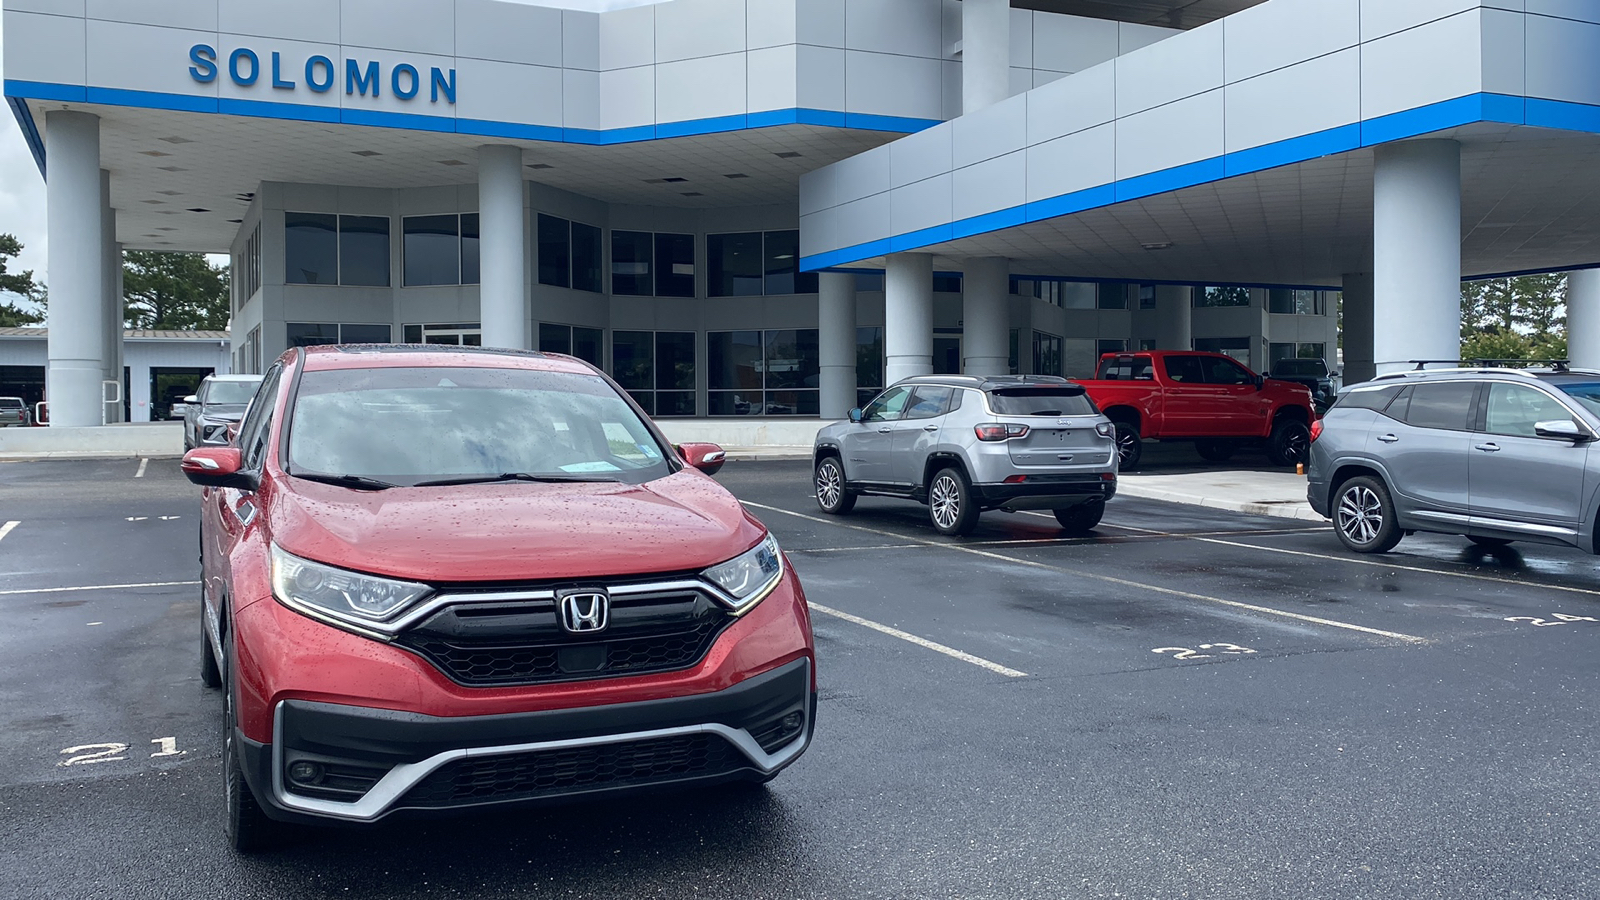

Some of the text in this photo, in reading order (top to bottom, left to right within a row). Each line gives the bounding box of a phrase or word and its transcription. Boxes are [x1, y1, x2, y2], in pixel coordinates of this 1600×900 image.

[188, 43, 457, 104] SOLOMON
[1503, 612, 1600, 627] 24
[1151, 643, 1258, 660] 23
[56, 736, 188, 767] 21
